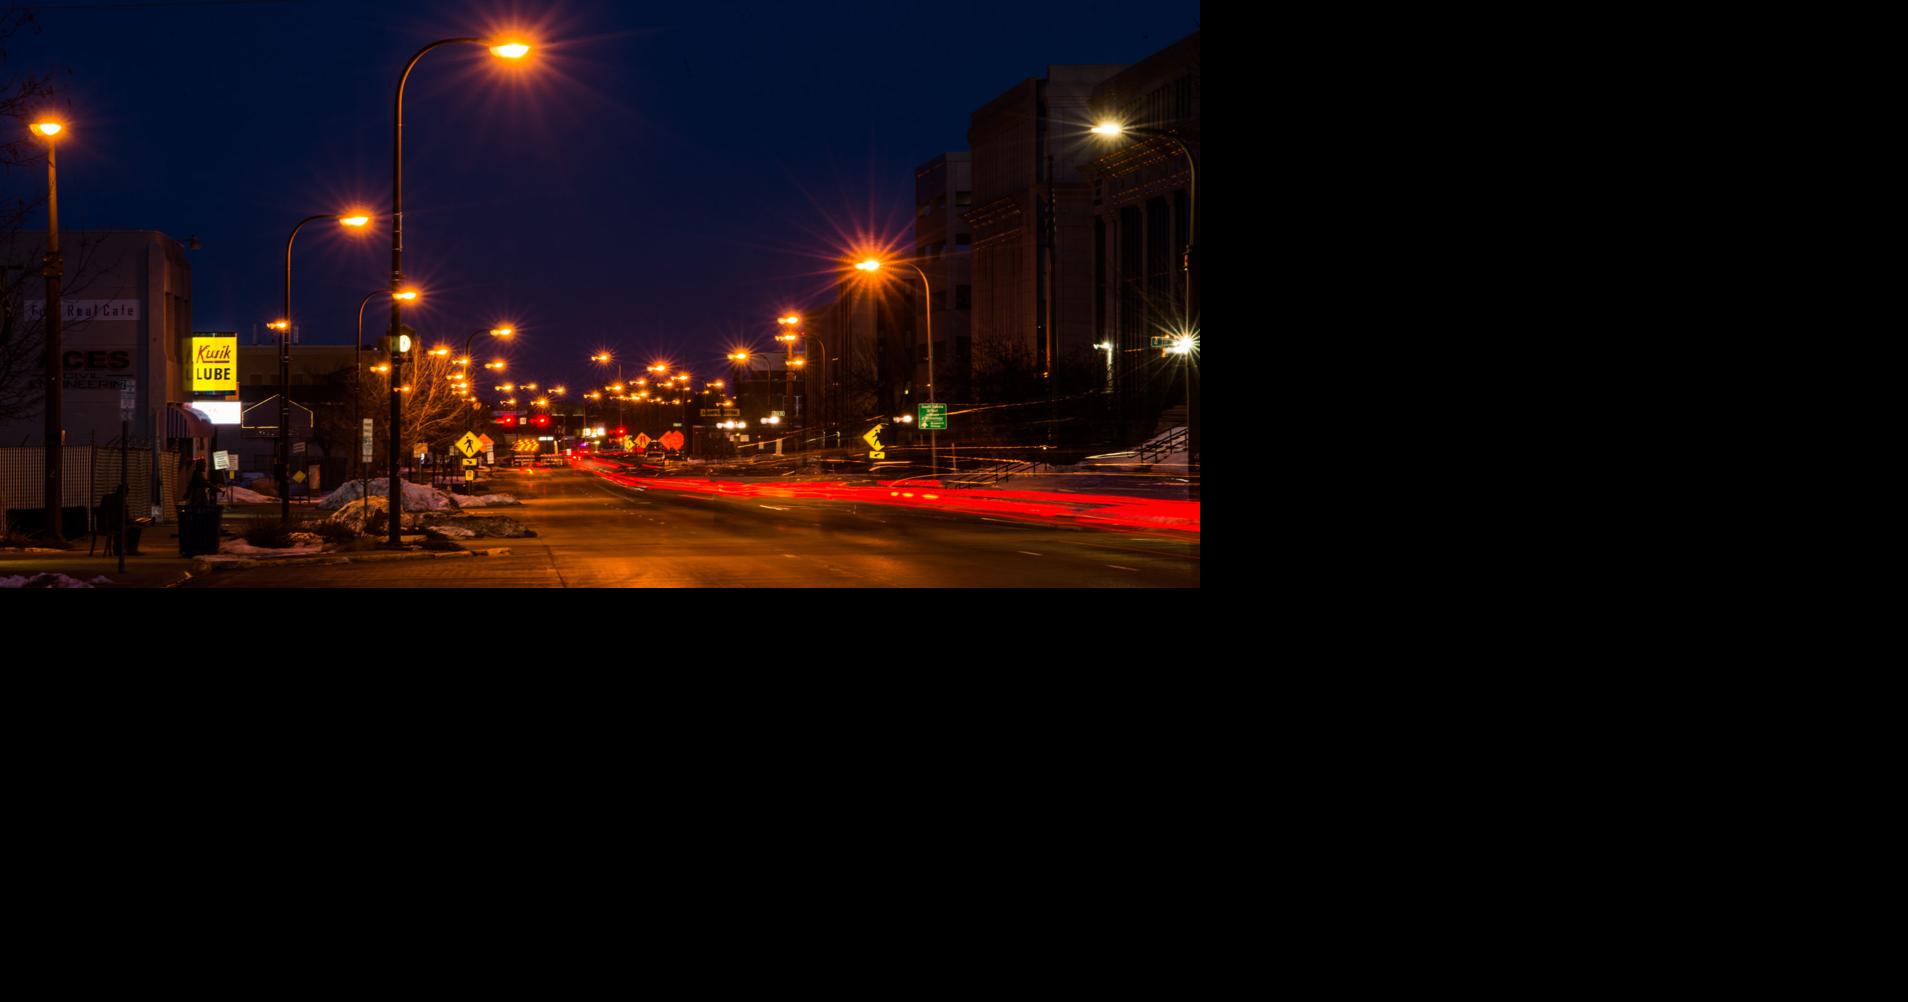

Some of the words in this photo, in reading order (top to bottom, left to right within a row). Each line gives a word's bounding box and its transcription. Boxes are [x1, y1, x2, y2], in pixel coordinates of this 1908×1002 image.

[67, 304, 98, 317] Real
[196, 345, 231, 363] Kwik
[197, 367, 231, 381] LUBE
